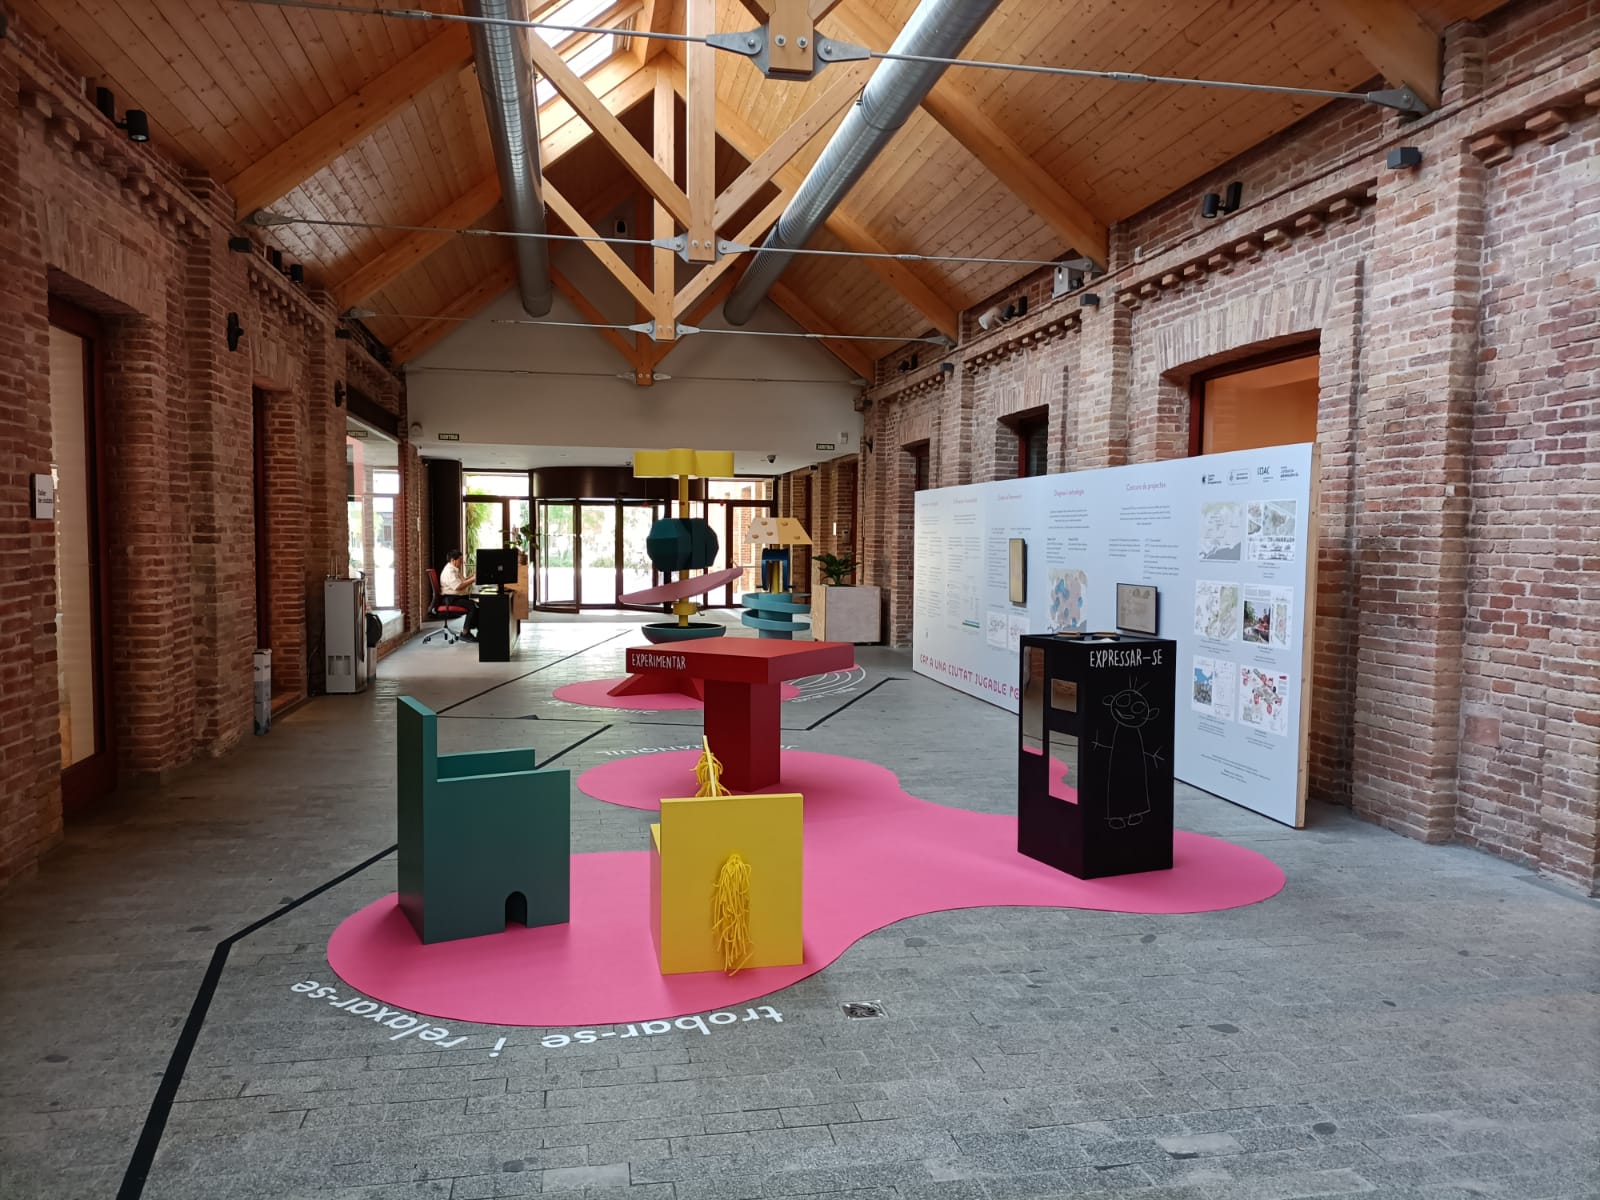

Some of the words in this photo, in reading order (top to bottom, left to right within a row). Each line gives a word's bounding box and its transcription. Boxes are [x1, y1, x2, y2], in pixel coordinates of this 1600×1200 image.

[631, 653, 686, 670] EXPERIMENTAR
[1089, 648, 1163, 668] EXPRESSAR-SE
[290, 979, 468, 1049] relaxar-se
[541, 1004, 785, 1049] trobar-se
[489, 1036, 508, 1059] i
